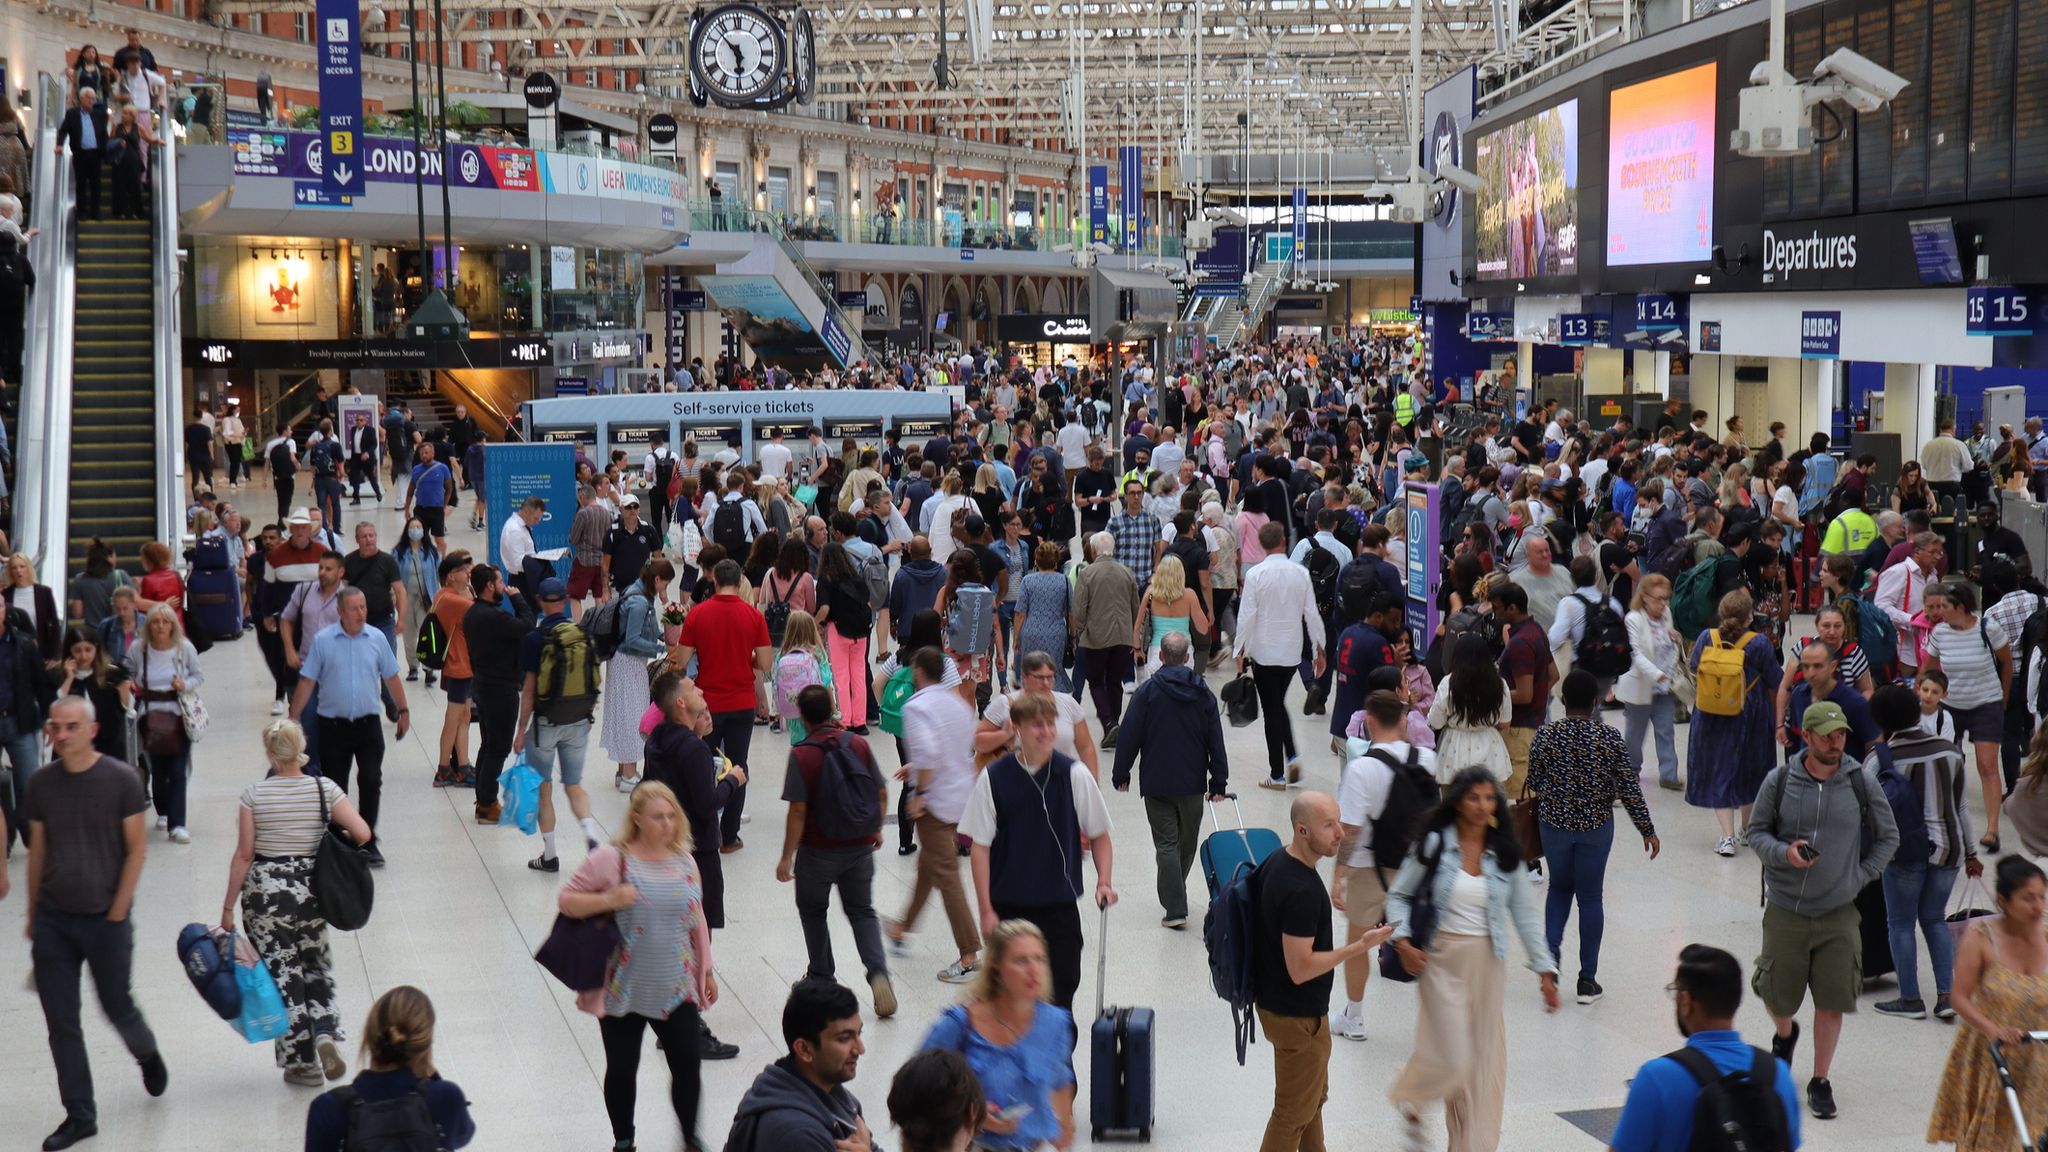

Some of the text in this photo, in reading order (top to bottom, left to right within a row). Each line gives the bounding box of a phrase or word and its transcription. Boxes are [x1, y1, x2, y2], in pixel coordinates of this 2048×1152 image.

[328, 44, 349, 55] Step
[330, 55, 348, 64] free
[325, 66, 353, 75] access
[527, 86, 553, 94] BENUGO
[330, 116, 353, 126] EXIT
[651, 124, 675, 132] BENUGO
[336, 134, 347, 151] 3
[1624, 119, 1697, 158] GO DOWN FOR
[602, 168, 625, 191] UEFA
[1620, 152, 1698, 190] BOURNEMOUTH
[1643, 186, 1673, 213] PRIDE
[1763, 229, 1857, 281] Departures
[1637, 301, 1646, 320] 14
[1651, 301, 1676, 320] 14
[1969, 296, 1984, 323] 15
[1993, 296, 2028, 322] 15
[1066, 318, 1085, 326] HOTEL
[1472, 317, 1491, 332] 12
[1565, 319, 1588, 336] 13
[208, 345, 226, 363] PRET
[309, 349, 425, 359] Freshly prepared Waterloo Station
[519, 344, 539, 361] PRET
[592, 340, 631, 359] Rail infomation
[673, 400, 814, 415] Self-service tickets
[1339, 636, 1353, 665] 2
